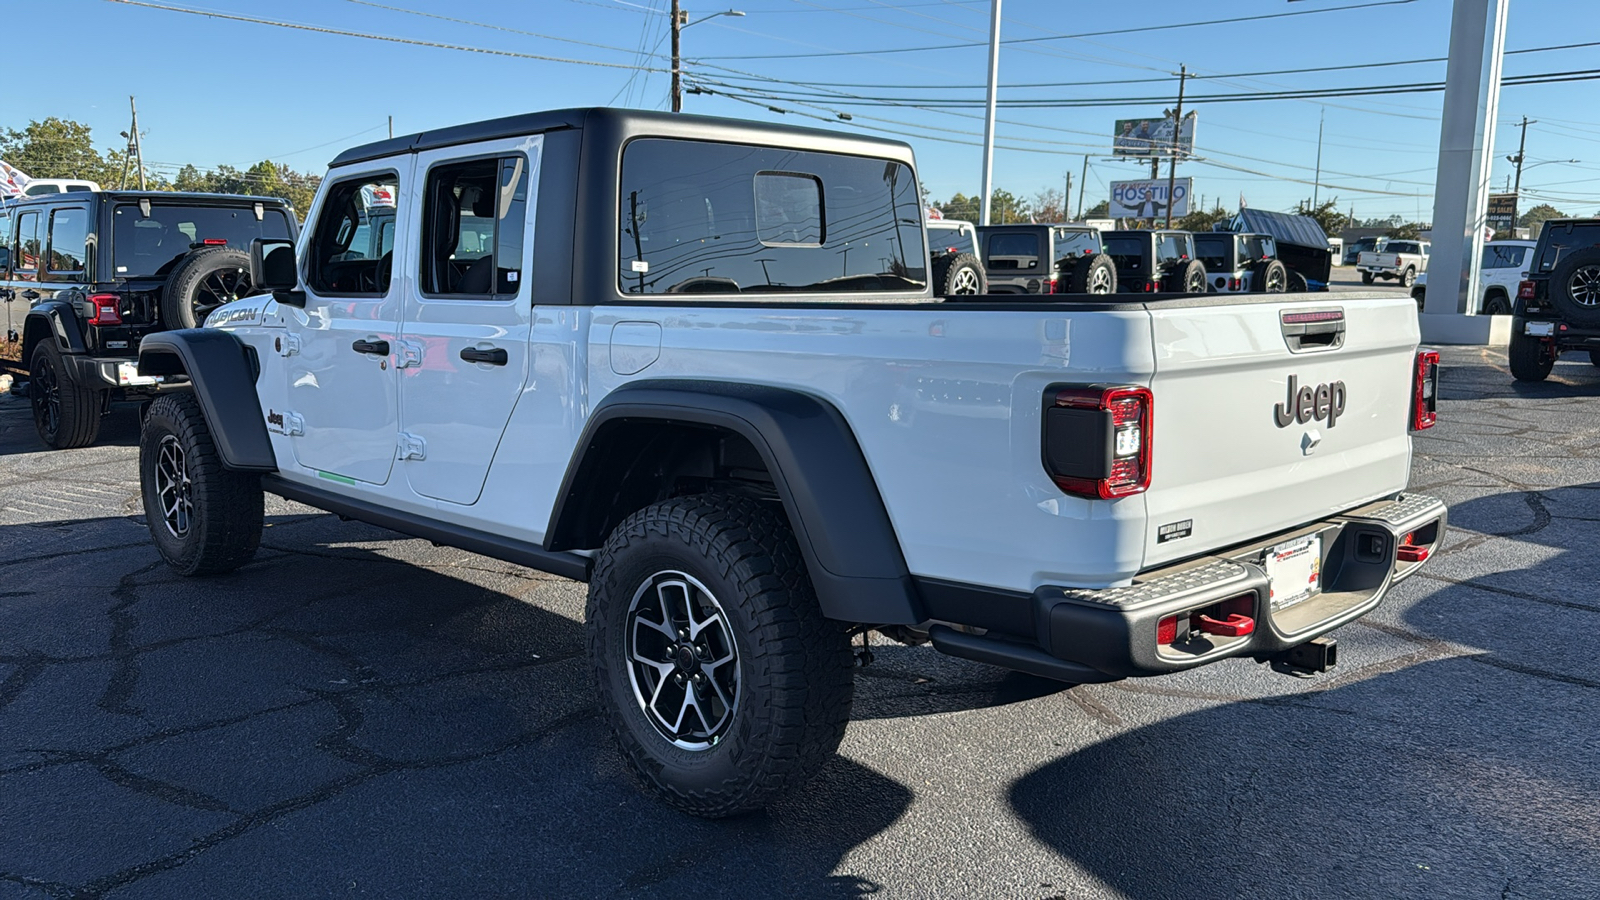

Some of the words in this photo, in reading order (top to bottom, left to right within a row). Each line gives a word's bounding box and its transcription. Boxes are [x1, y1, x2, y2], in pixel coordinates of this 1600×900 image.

[206, 307, 259, 325] RUBICON
[1273, 373, 1347, 429] Jeep
[267, 408, 284, 430] Jeep
